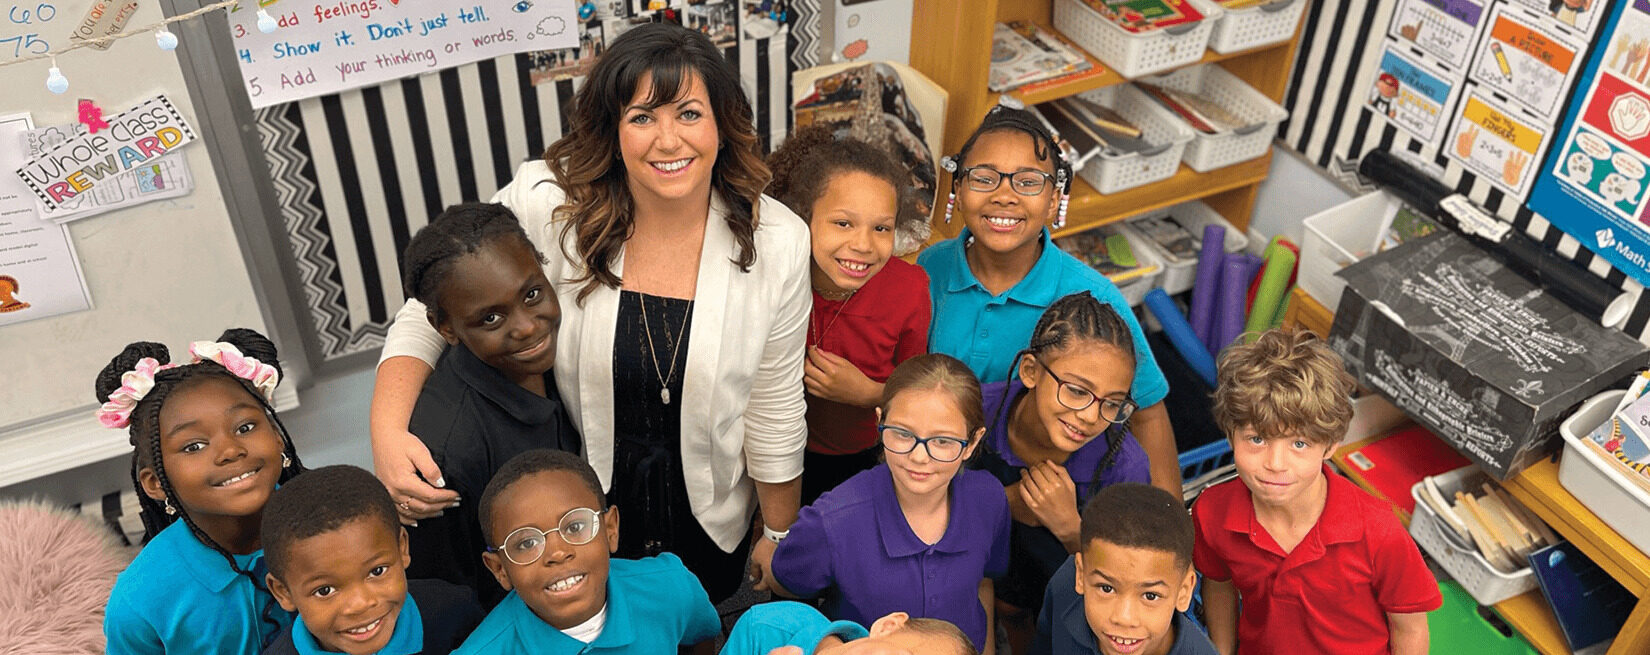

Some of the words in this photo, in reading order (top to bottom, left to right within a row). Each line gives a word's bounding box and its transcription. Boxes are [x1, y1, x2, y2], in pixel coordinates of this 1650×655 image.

[9, 3, 56, 25] 60
[69, 18, 98, 42] You
[234, 24, 250, 39] 3.
[277, 11, 300, 28] dd
[314, 0, 382, 23] feelings.
[0, 33, 49, 57] 75
[239, 48, 256, 63] 4.
[273, 41, 321, 59] Show
[334, 30, 356, 46] it.
[366, 18, 412, 41] Don't
[420, 13, 448, 36] just
[458, 6, 490, 23] tell.
[280, 67, 317, 89] Add
[335, 60, 367, 82] your
[375, 49, 437, 68] thinking
[444, 42, 461, 54] or
[472, 28, 518, 47] words.
[27, 136, 109, 184] Whole
[45, 127, 184, 204] REWARD
[1615, 241, 1646, 269] Math
[1466, 440, 1495, 465] REPORTS
